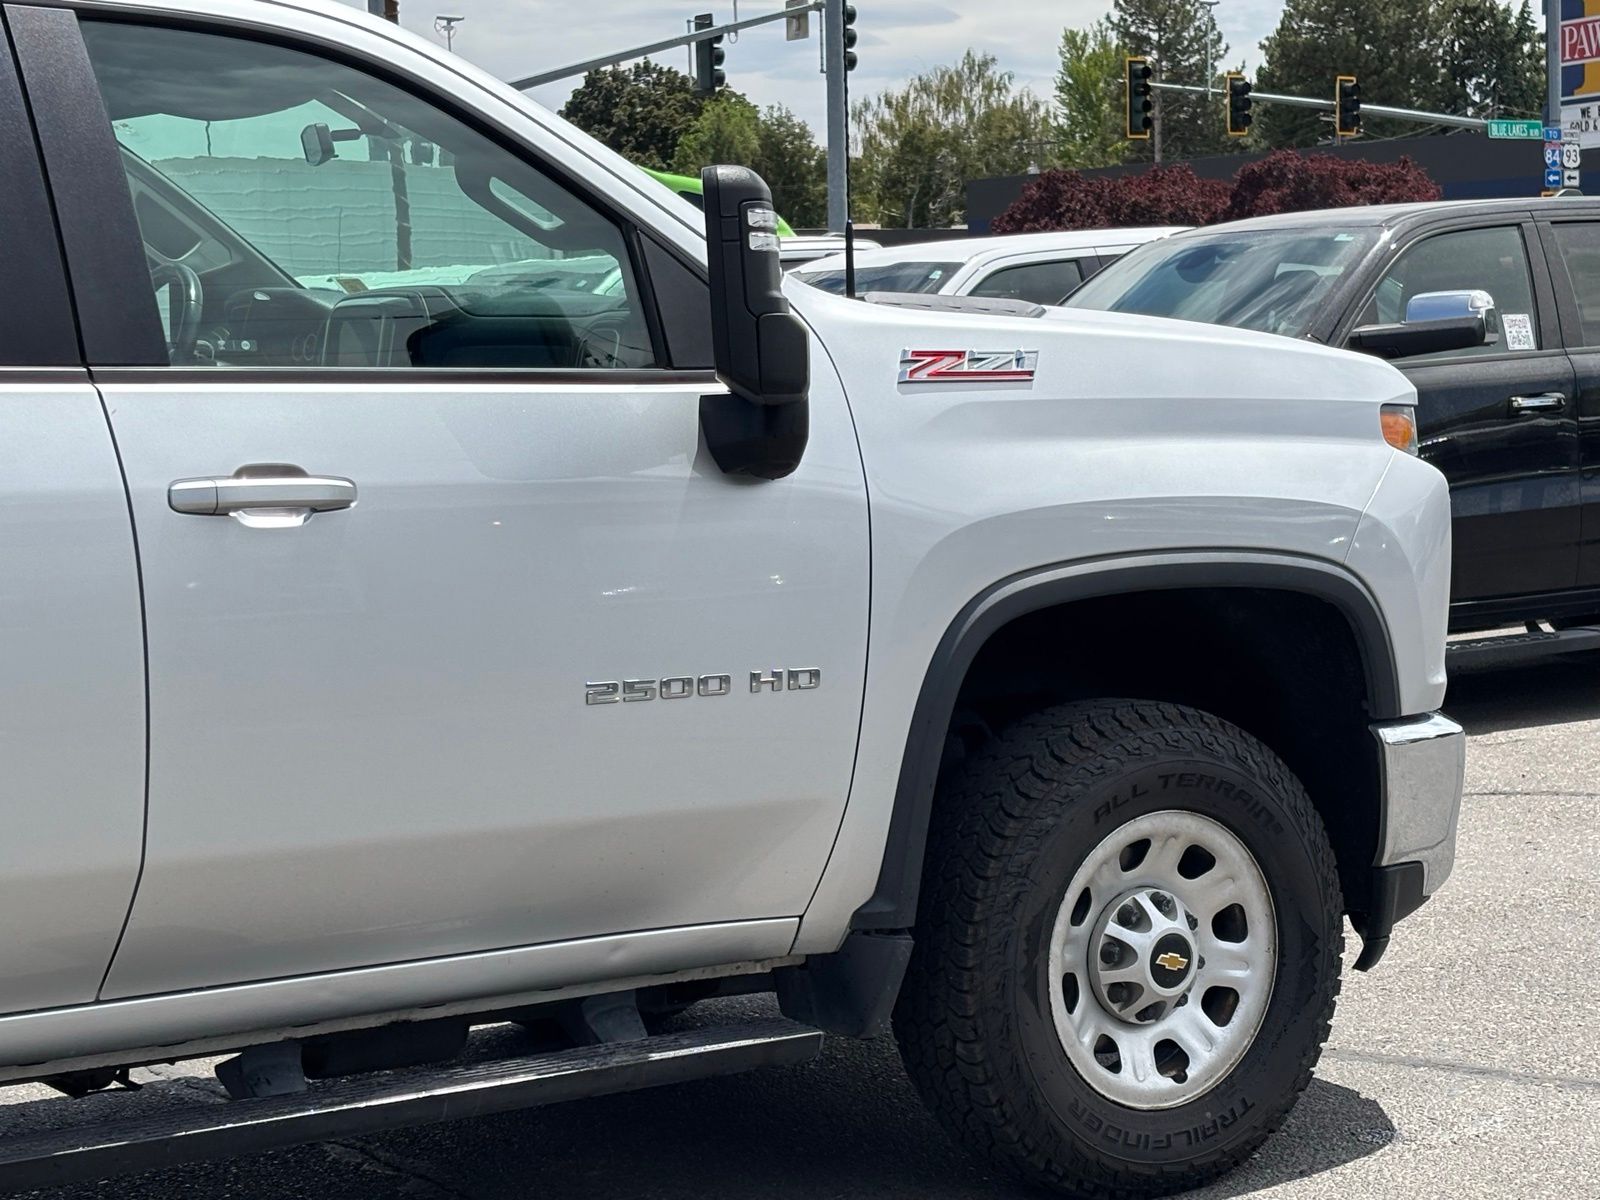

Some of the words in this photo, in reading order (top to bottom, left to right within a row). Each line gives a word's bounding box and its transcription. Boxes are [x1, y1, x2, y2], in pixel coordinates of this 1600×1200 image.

[1580, 106, 1591, 119] WE
[1491, 123, 1507, 136] BLUE
[1508, 123, 1528, 136] LAKES
[1548, 130, 1558, 138] TO
[1545, 149, 1560, 164] 84
[1565, 149, 1578, 163] 93
[898, 348, 1038, 384] Z71
[586, 674, 731, 705] 2500
[750, 667, 821, 693] HD
[1093, 783, 1149, 825] ALL
[1068, 1098, 1256, 1151] TRAILFINDER
